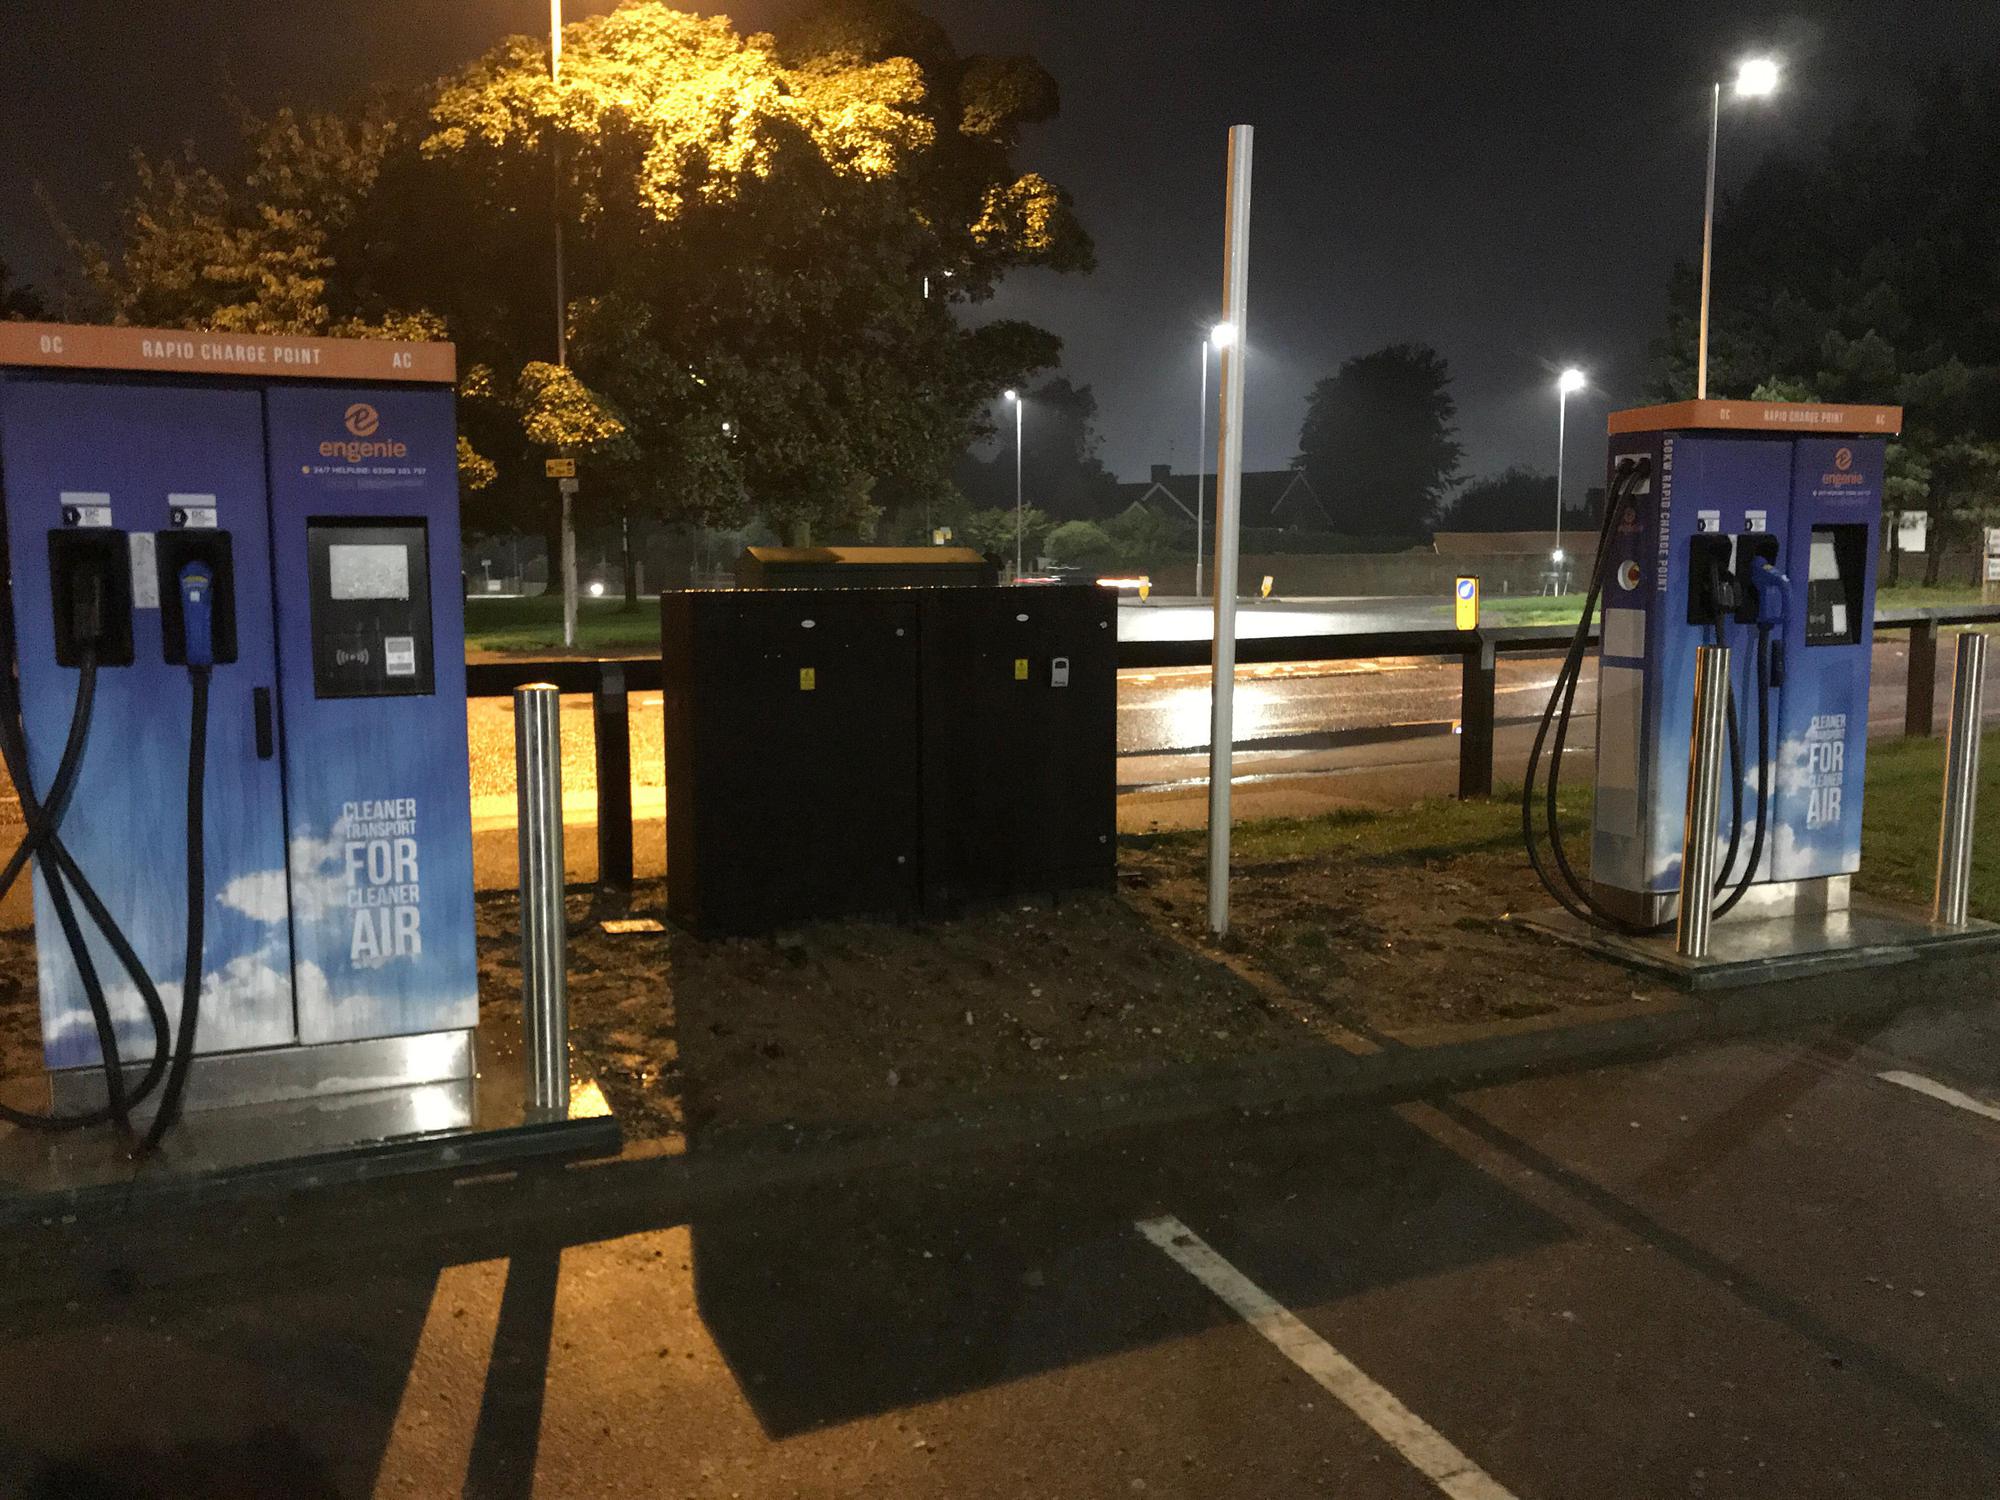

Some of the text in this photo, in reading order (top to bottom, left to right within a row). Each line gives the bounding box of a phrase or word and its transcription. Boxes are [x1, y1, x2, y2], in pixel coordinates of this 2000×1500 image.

[40, 335, 63, 354] DC
[142, 340, 321, 365] RAPID CHARGE POINT
[392, 352, 413, 368] AC
[1764, 409, 1787, 422] RAPID
[319, 439, 407, 463] engenie
[1661, 475, 1672, 508] RAPID
[1658, 513, 1670, 556] CHARGE
[1657, 560, 1668, 592] POINT
[1809, 741, 1845, 773] FOR
[343, 798, 417, 821] CLEANER
[1806, 786, 1842, 823] AIR
[346, 820, 417, 839] TRANSPORT
[345, 838, 419, 887] FOR
[347, 884, 420, 907] CLEANER
[350, 905, 422, 960] AIR
